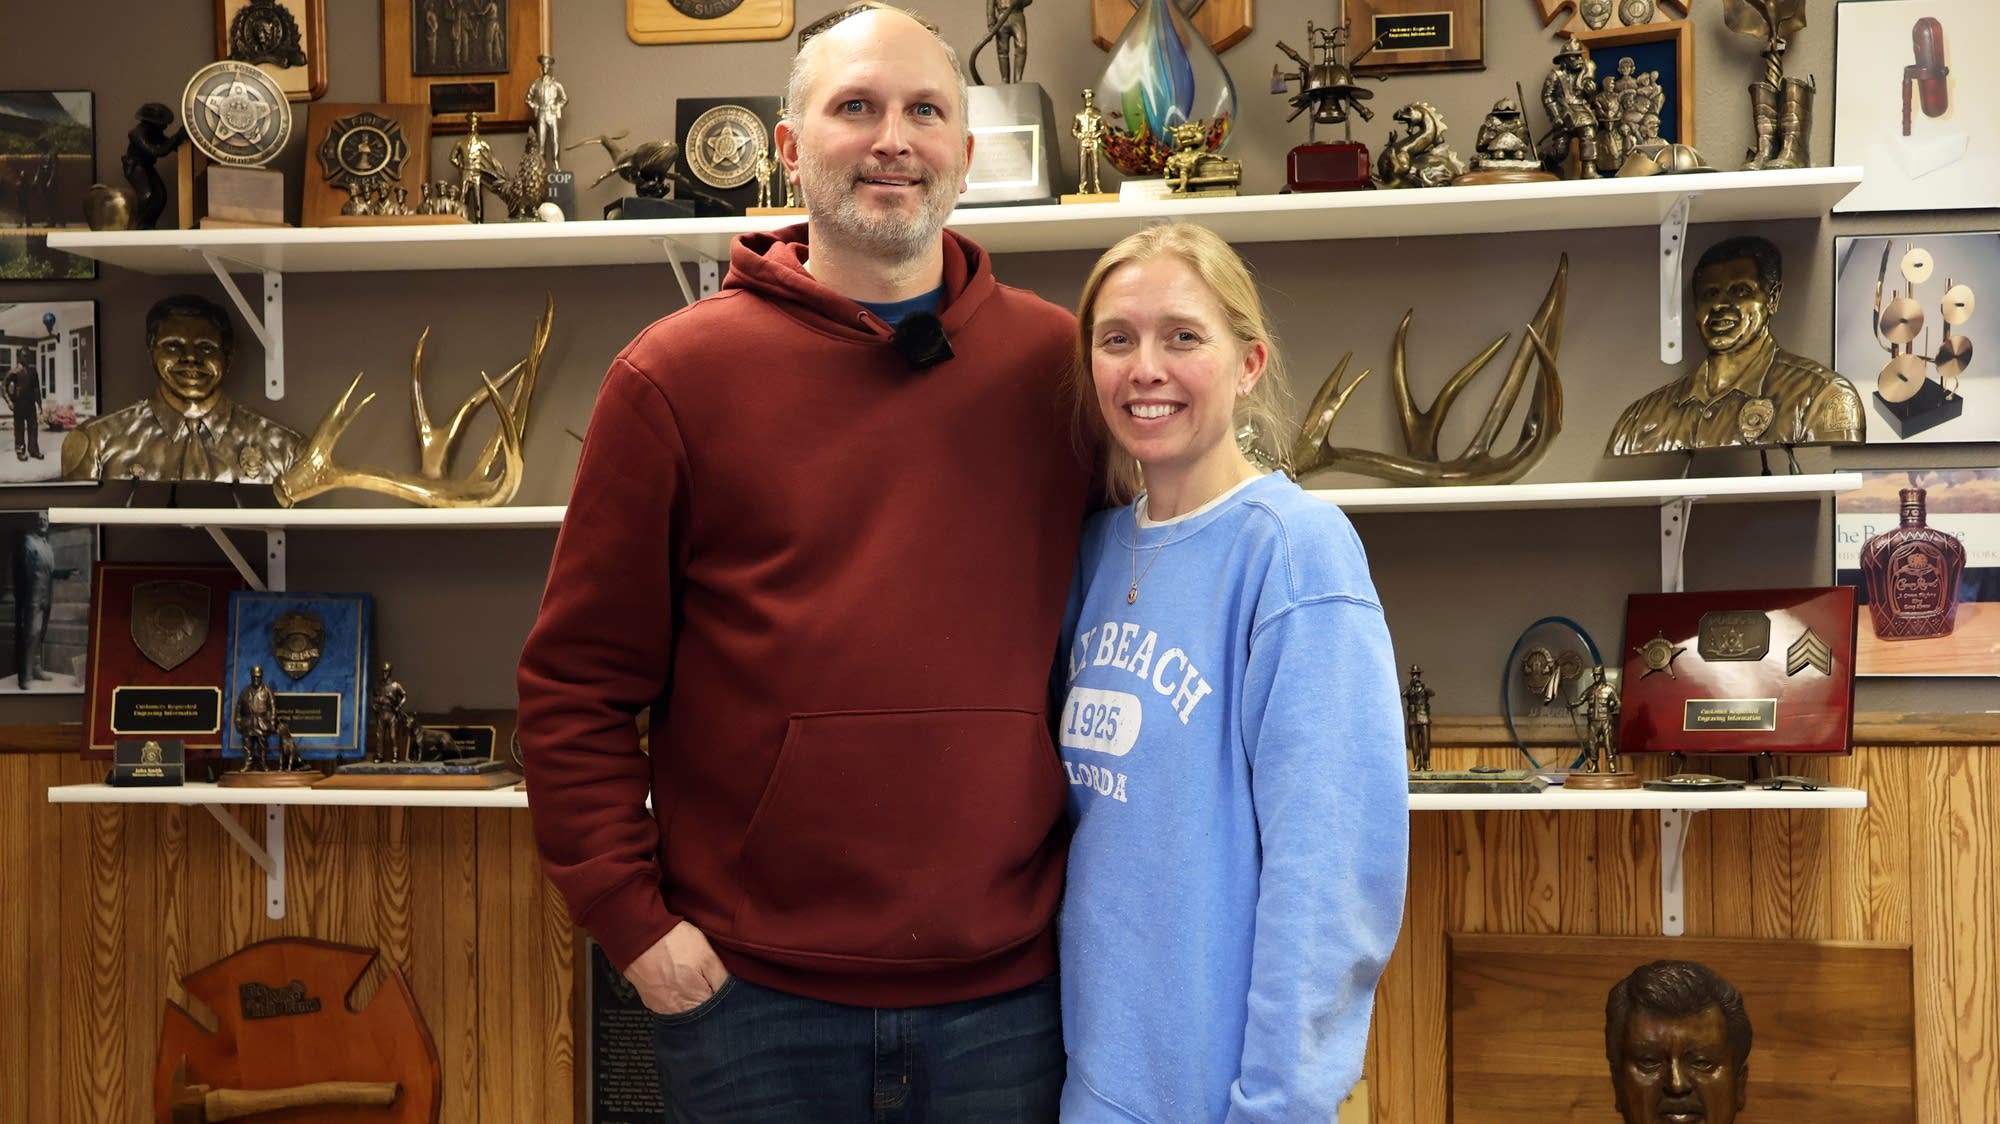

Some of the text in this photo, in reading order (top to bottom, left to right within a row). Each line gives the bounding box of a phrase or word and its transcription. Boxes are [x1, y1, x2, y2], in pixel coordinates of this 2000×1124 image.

[547, 173, 572, 184] COP
[1837, 524, 1860, 543] he
[1092, 621, 1213, 726] BEACH
[1066, 701, 1121, 742] 1925
[1063, 760, 1129, 804] LORDA
